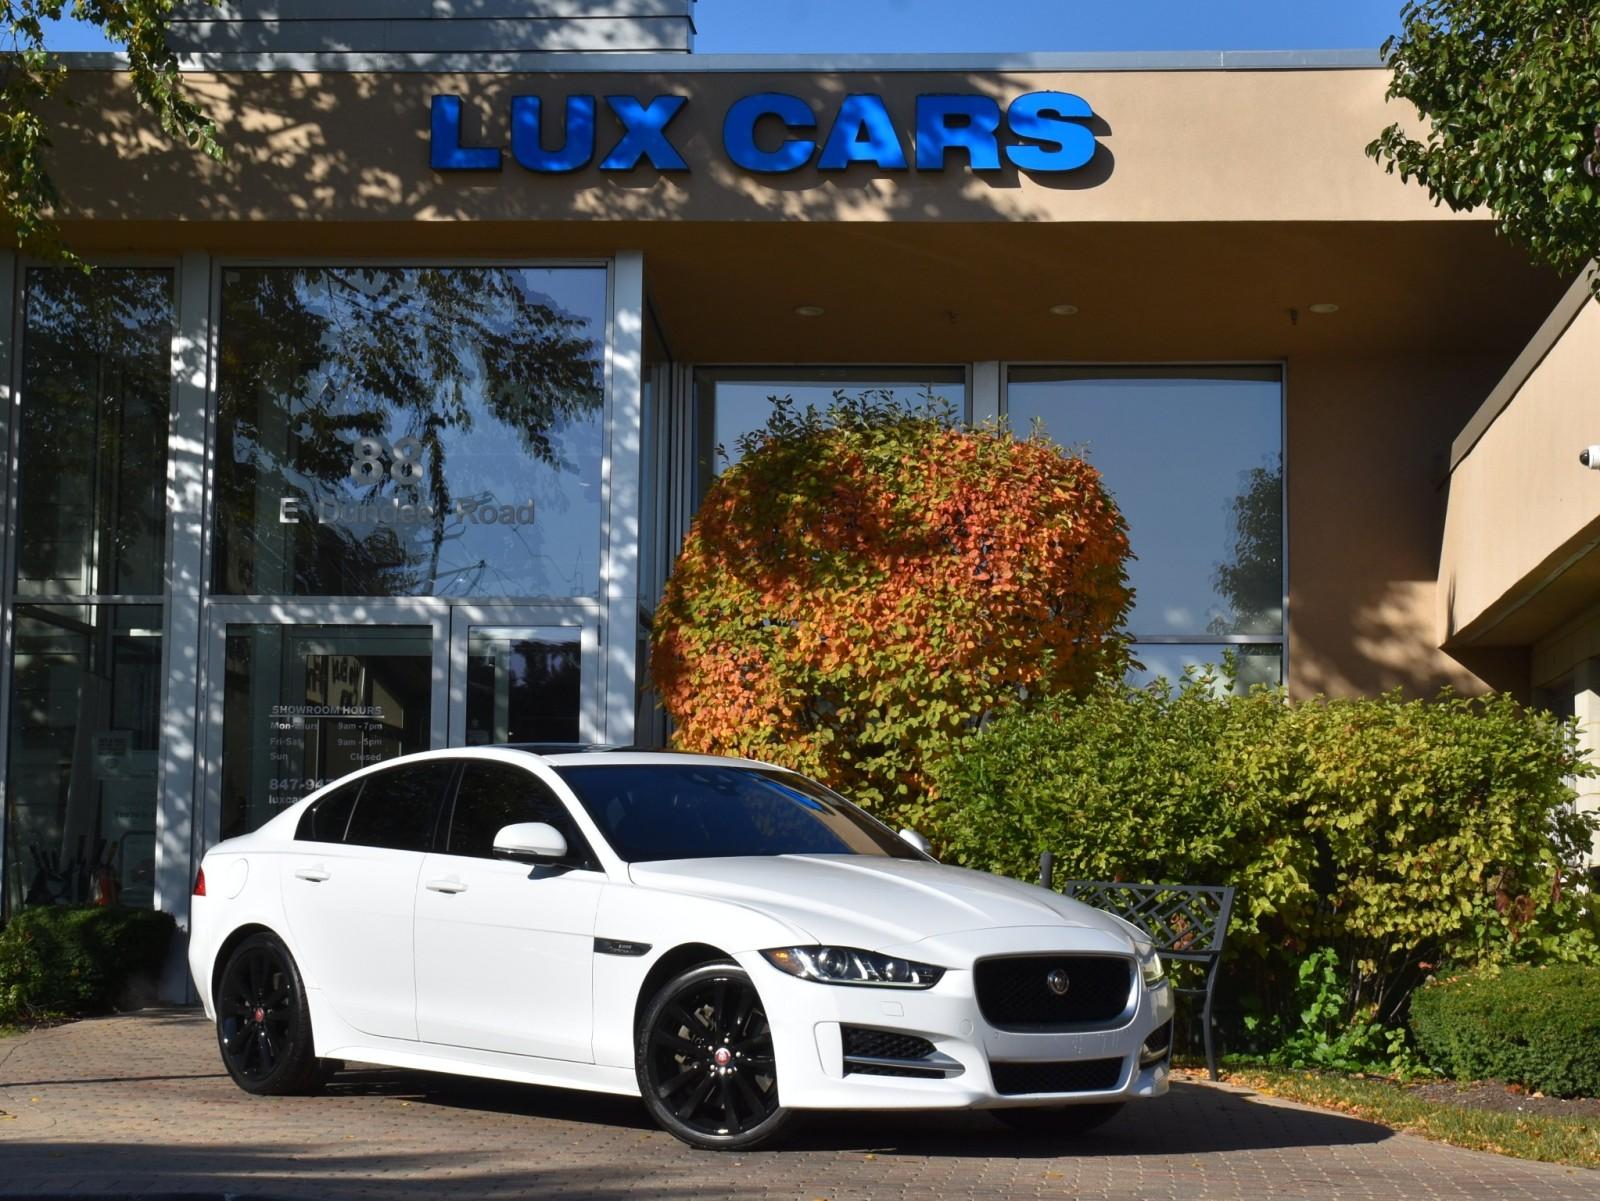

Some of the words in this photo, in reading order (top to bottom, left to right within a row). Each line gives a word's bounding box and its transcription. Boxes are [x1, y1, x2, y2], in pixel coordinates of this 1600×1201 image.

[429, 94, 690, 173] LUX
[722, 90, 1096, 174] CARS
[350, 436, 424, 485] 88
[279, 497, 299, 523] E
[456, 499, 535, 525] Road
[271, 705, 340, 715] SHOWROOM
[342, 706, 384, 715] HOURS
[337, 722, 356, 730] 9am
[364, 722, 383, 732] 7pm
[337, 738, 356, 746] 9am
[363, 738, 382, 748] 5pm
[270, 752, 288, 761] Sun
[350, 753, 382, 761] Closed
